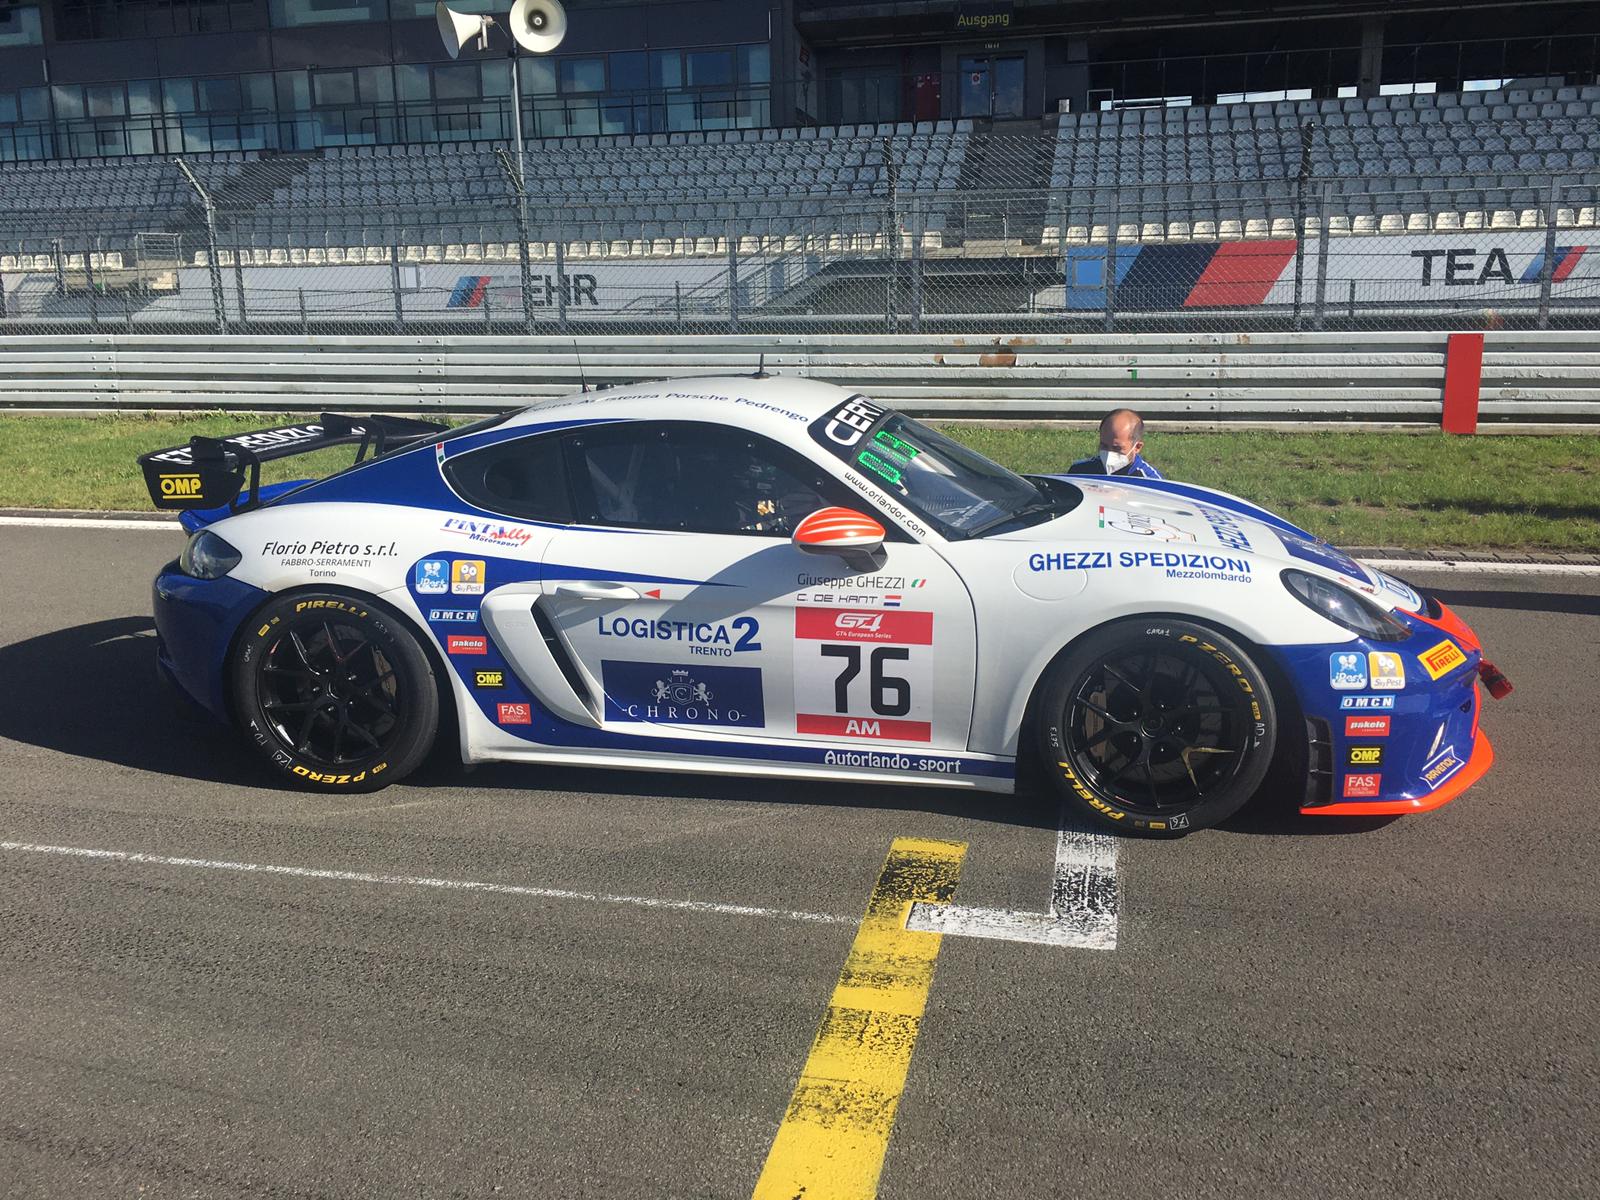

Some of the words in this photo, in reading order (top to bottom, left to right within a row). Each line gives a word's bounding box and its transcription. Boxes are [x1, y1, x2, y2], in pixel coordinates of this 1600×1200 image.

[957, 14, 1009, 27] Ausgang
[666, 392, 728, 402] Porsche
[735, 397, 808, 423] Pedrengo
[161, 478, 202, 495] OMP
[262, 541, 306, 556] Florio
[310, 540, 359, 555] Pietro
[363, 541, 398, 556] s.r.l.
[469, 533, 519, 548] Motorsport
[281, 558, 371, 568] FABBRO-SERRAMENTI
[1029, 552, 1112, 572] GHEZZI
[1119, 552, 1251, 573] SPEDIZIONI
[310, 569, 336, 577] Torino
[1166, 568, 1252, 583] Mezzolombardo
[797, 573, 853, 589] Giuseppe
[856, 576, 905, 589] GHEZZI
[813, 594, 833, 603] DE
[296, 600, 368, 618] PIRELLI
[431, 610, 476, 620] OMCN
[599, 616, 730, 644] LOGISTICA
[732, 616, 762, 652] 2
[848, 631, 874, 639] European
[452, 640, 483, 648] pakelo
[689, 645, 732, 657] TRENTO
[1426, 644, 1460, 672] PIRELLI
[477, 674, 502, 684] OMP
[821, 644, 911, 717] 76
[1335, 672, 1363, 683] iPest
[1343, 697, 1392, 707] OMCN
[628, 704, 740, 722] CHRONO
[845, 719, 881, 736] AM
[1350, 721, 1385, 729] pakelo
[1351, 750, 1380, 761] OMP
[1057, 761, 1126, 821] PIRELLI
